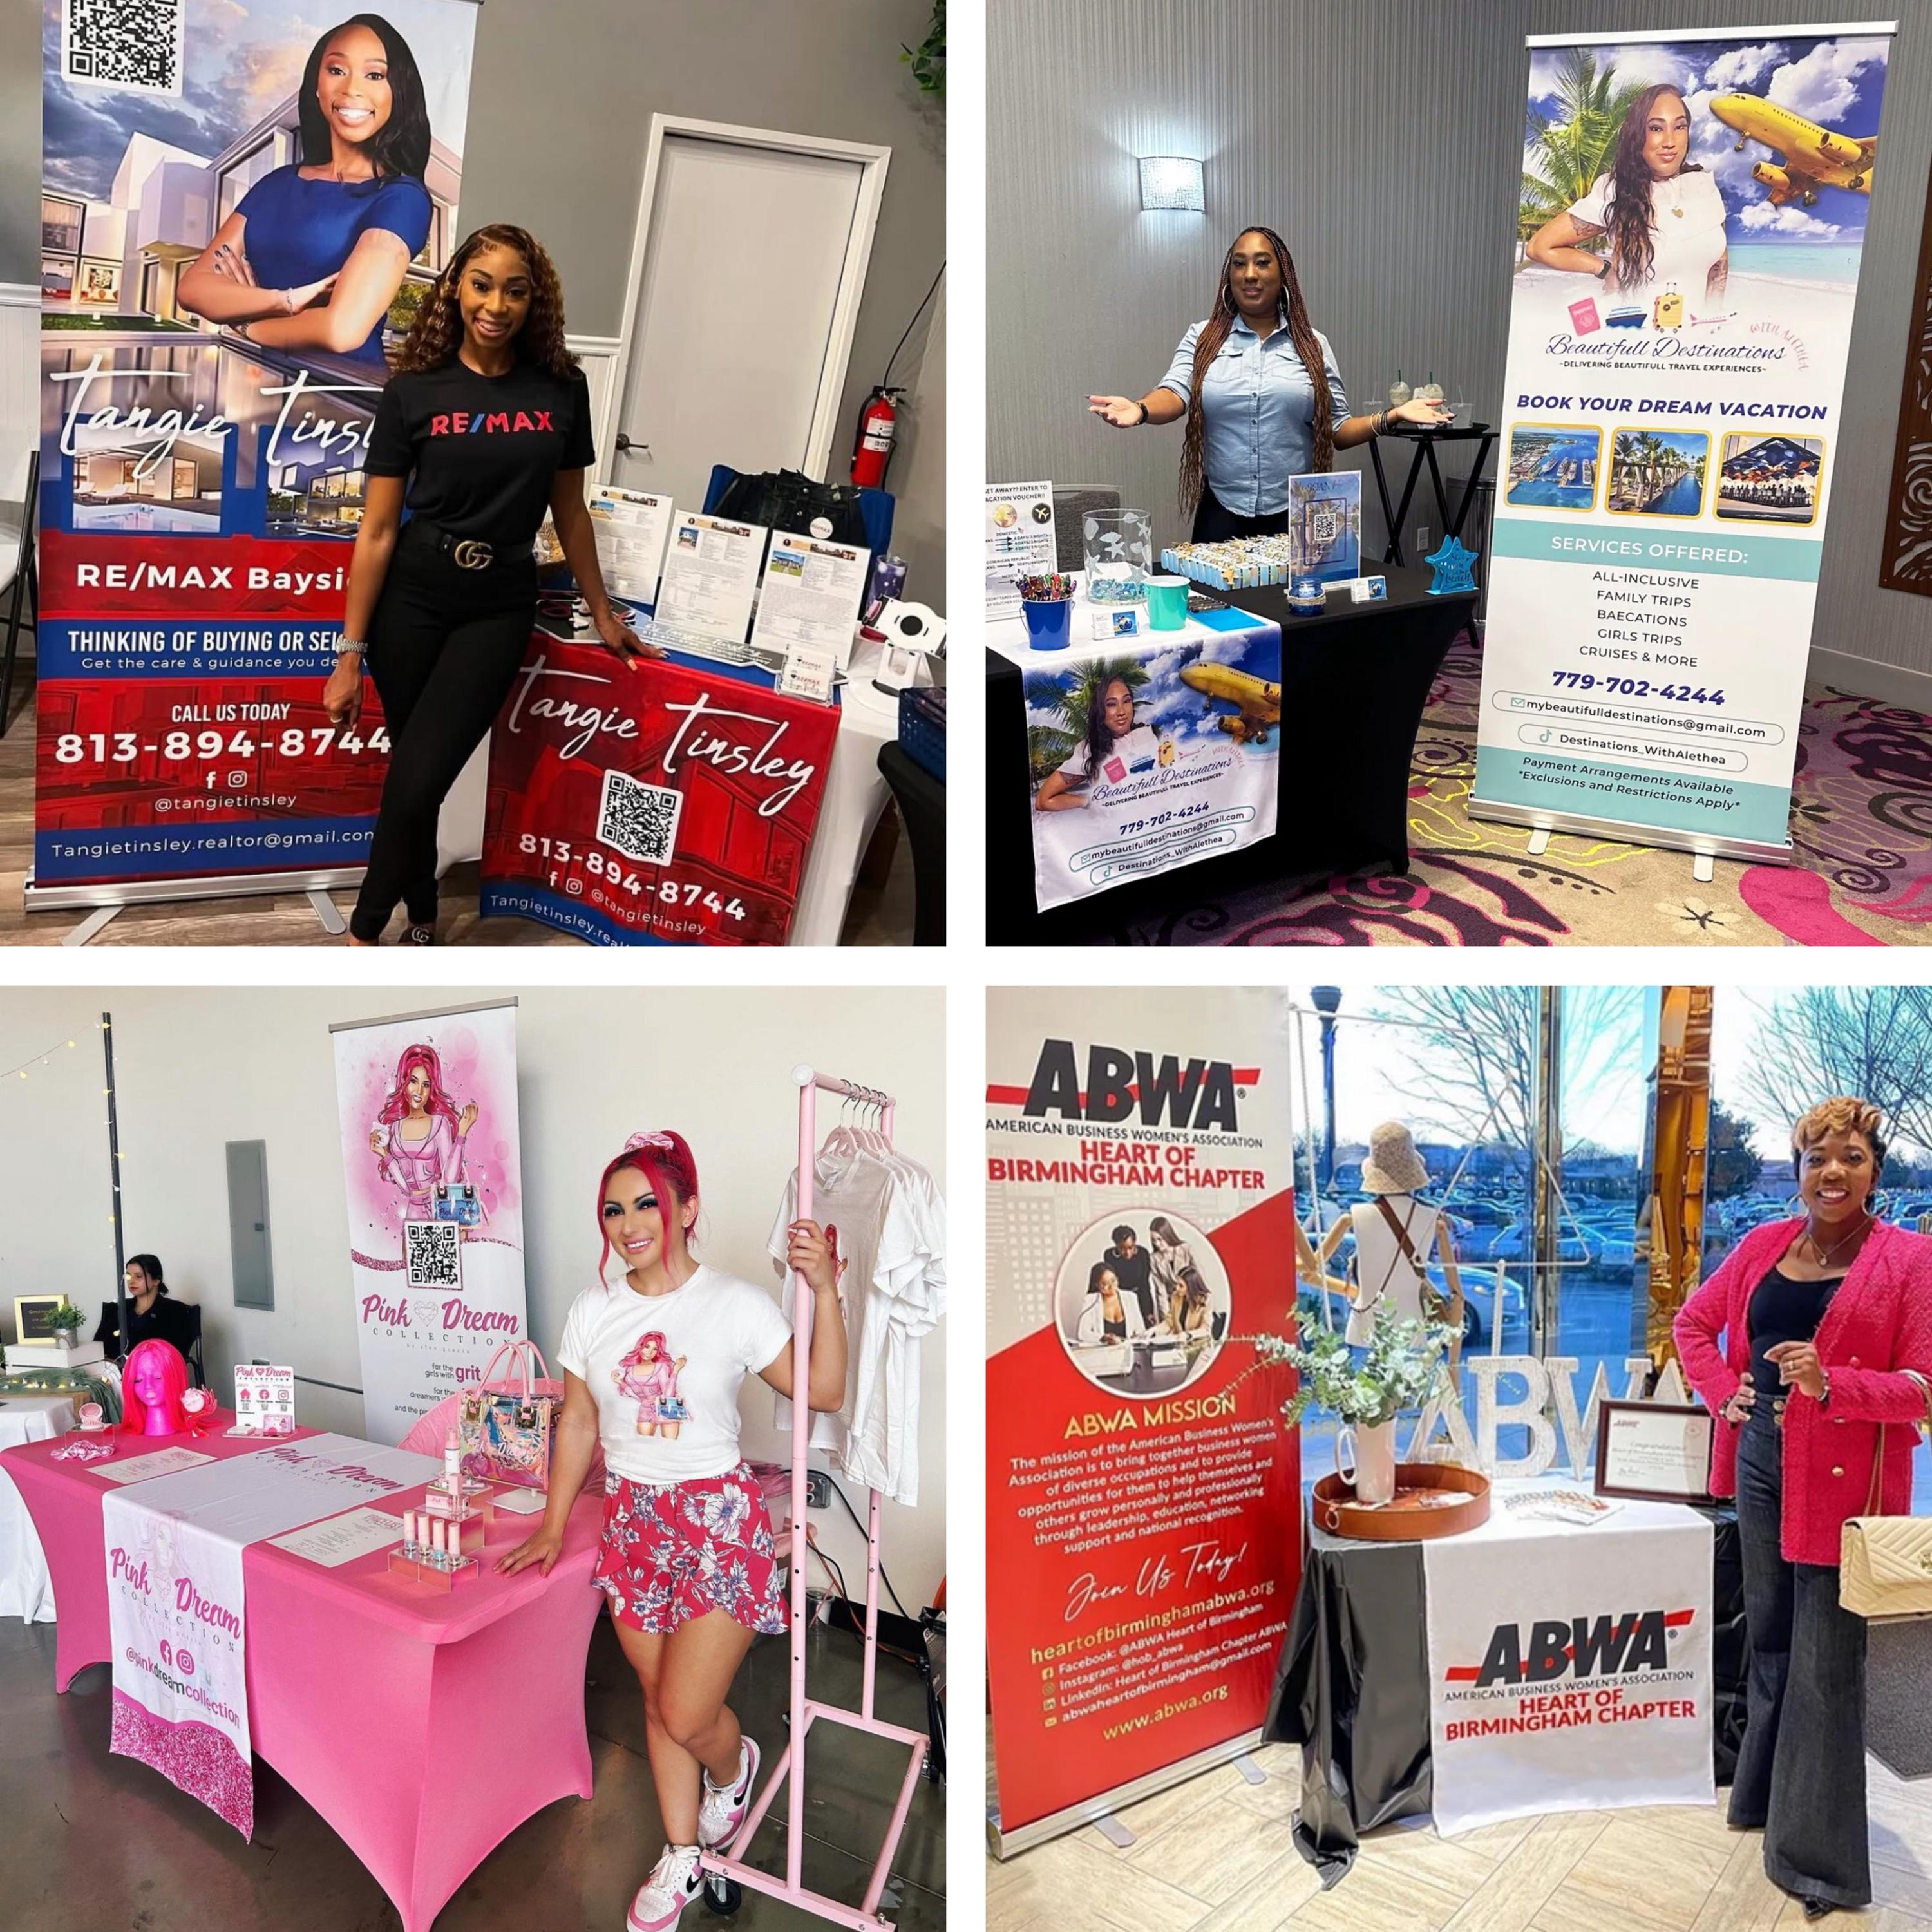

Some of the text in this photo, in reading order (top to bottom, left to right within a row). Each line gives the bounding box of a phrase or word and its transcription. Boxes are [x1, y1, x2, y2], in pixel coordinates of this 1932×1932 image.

[1546, 334, 1786, 360] Beautifull Destinations
[50, 354, 232, 480] Tangie
[431, 411, 554, 436] RE/MAX
[1517, 395, 1827, 419] BOOK YOUR DREAM VACATION
[1551, 536, 1748, 564] SERVICES OFFERED:
[77, 562, 353, 596] RE/MAX Baysi
[1593, 571, 1700, 589] ALL-INCLUSIVE
[1597, 590, 1692, 607] FAMILY TRIPS
[1597, 609, 1687, 627] BAECATIONS
[68, 630, 303, 652] THINKING OF BUYING OR
[1598, 629, 1682, 646] GIRLS TRIPS
[82, 658, 111, 668] Get
[118, 658, 145, 668] the
[151, 659, 185, 668] care
[193, 658, 202, 668] &
[209, 658, 282, 670] guidance
[288, 658, 314, 669] you
[1579, 645, 1698, 667] CRUISES & MORE
[1552, 671, 1725, 705] 779-702-4244
[172, 703, 290, 723] CALL US TODAY
[1526, 699, 1766, 739] mybeautifulldestinations@gmail.com
[55, 726, 392, 763] 813-894-8744
[509, 654, 815, 817] Tangie Tinsley
[1560, 734, 1726, 765] Destinations_WithAlethea
[1092, 758, 1233, 801] Beautifull Destinations
[1522, 757, 1734, 795] Payment Arrangements Available
[1589, 781, 1613, 792] and
[1616, 784, 1692, 803] Restrictions
[155, 794, 296, 812] @tangietinsley
[1119, 801, 1209, 835] 779-702-4244
[1092, 813, 1244, 860] mybeautifulldestinations@gmail.com
[1119, 836, 1222, 871] Destinations_WithAlethea
[518, 833, 746, 922] 813-894-8744
[591, 888, 706, 935] @tangietinsley
[986, 1119, 1262, 1148] AMERICAN BUSINESS WOMEN'S ASSOCIATION
[1081, 1141, 1195, 1166] HEART OF
[988, 1157, 1265, 1189] BIRMINGHAM CHAPTER
[362, 1294, 520, 1334] Pink Dream
[236, 1366, 291, 1378] Pink Dream
[456, 1365, 481, 1383] grit
[410, 1392, 440, 1401] dreamers
[1064, 1394, 1236, 1439] ABWA MISSION
[1009, 1432, 1276, 1487] Association is to bring together business women
[1010, 1418, 1274, 1470] The mission of the American Business Women's
[258, 1448, 404, 1490] Pink Dream
[1046, 1450, 1252, 1497] of diverse occupations and to provide
[110, 1547, 151, 1595] Pink
[175, 1577, 241, 1640] Dream
[1064, 1540, 1247, 1622] Join Us Today!
[121, 1586, 234, 1652] COLLECTION
[1030, 1579, 1274, 1665] heartofbirminghamabwa.org
[1059, 1604, 1264, 1674] Facebook: @ABWA Heart of Birmingham
[1060, 1643, 1184, 1690] Instagram: @hob_abwa
[1061, 1621, 1287, 1707] LinkedIn: Heart of Birmingham Chapter ABWA
[126, 1647, 240, 1728] @pinkdreamcollection
[1062, 1642, 1273, 1722] abwaheartofbirmingham@gmail.com
[1444, 1671, 1694, 1702] AMERICAN BUSINESS WOMEN'S ASSOCIATION
[1103, 1683, 1229, 1741] www.abwa.org
[1520, 1688, 1624, 1715] HEART OF
[1446, 1700, 1696, 1741] BIRMINGHAM CHAPTER
